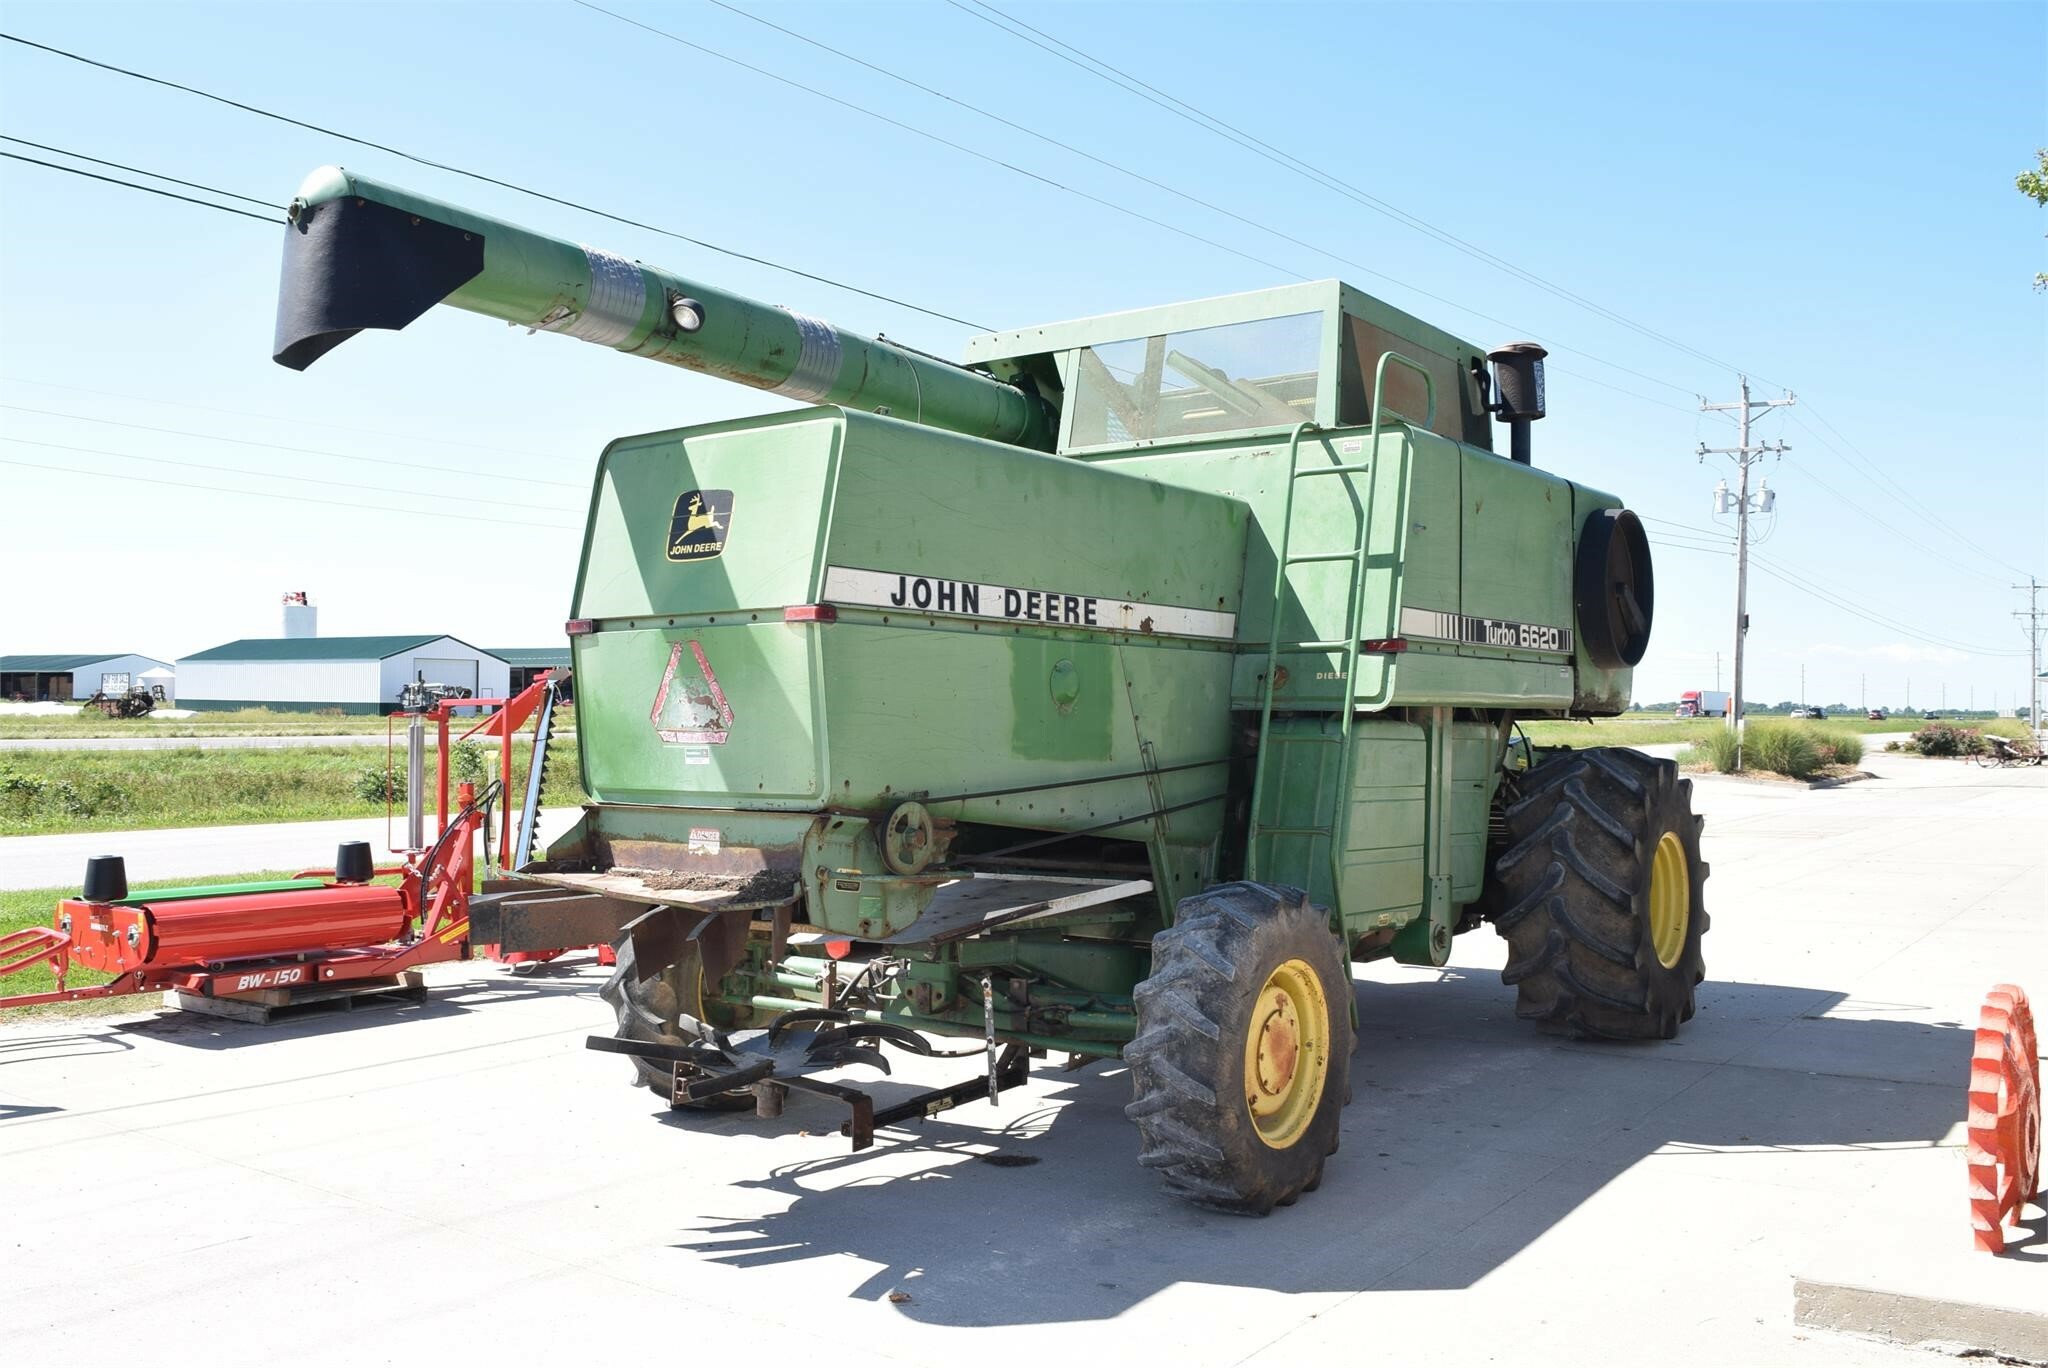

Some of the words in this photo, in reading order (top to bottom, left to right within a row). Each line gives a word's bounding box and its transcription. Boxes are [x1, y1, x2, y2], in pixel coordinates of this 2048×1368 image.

[670, 544, 693, 555] JOHN
[693, 541, 722, 553] DEERE
[891, 576, 979, 614] JOHN
[1004, 588, 1097, 625] DEERE
[1483, 620, 1516, 645] Turbo
[1520, 624, 1559, 650] 6620
[1316, 672, 1351, 680] DIESE
[237, 968, 301, 990] BW-150
